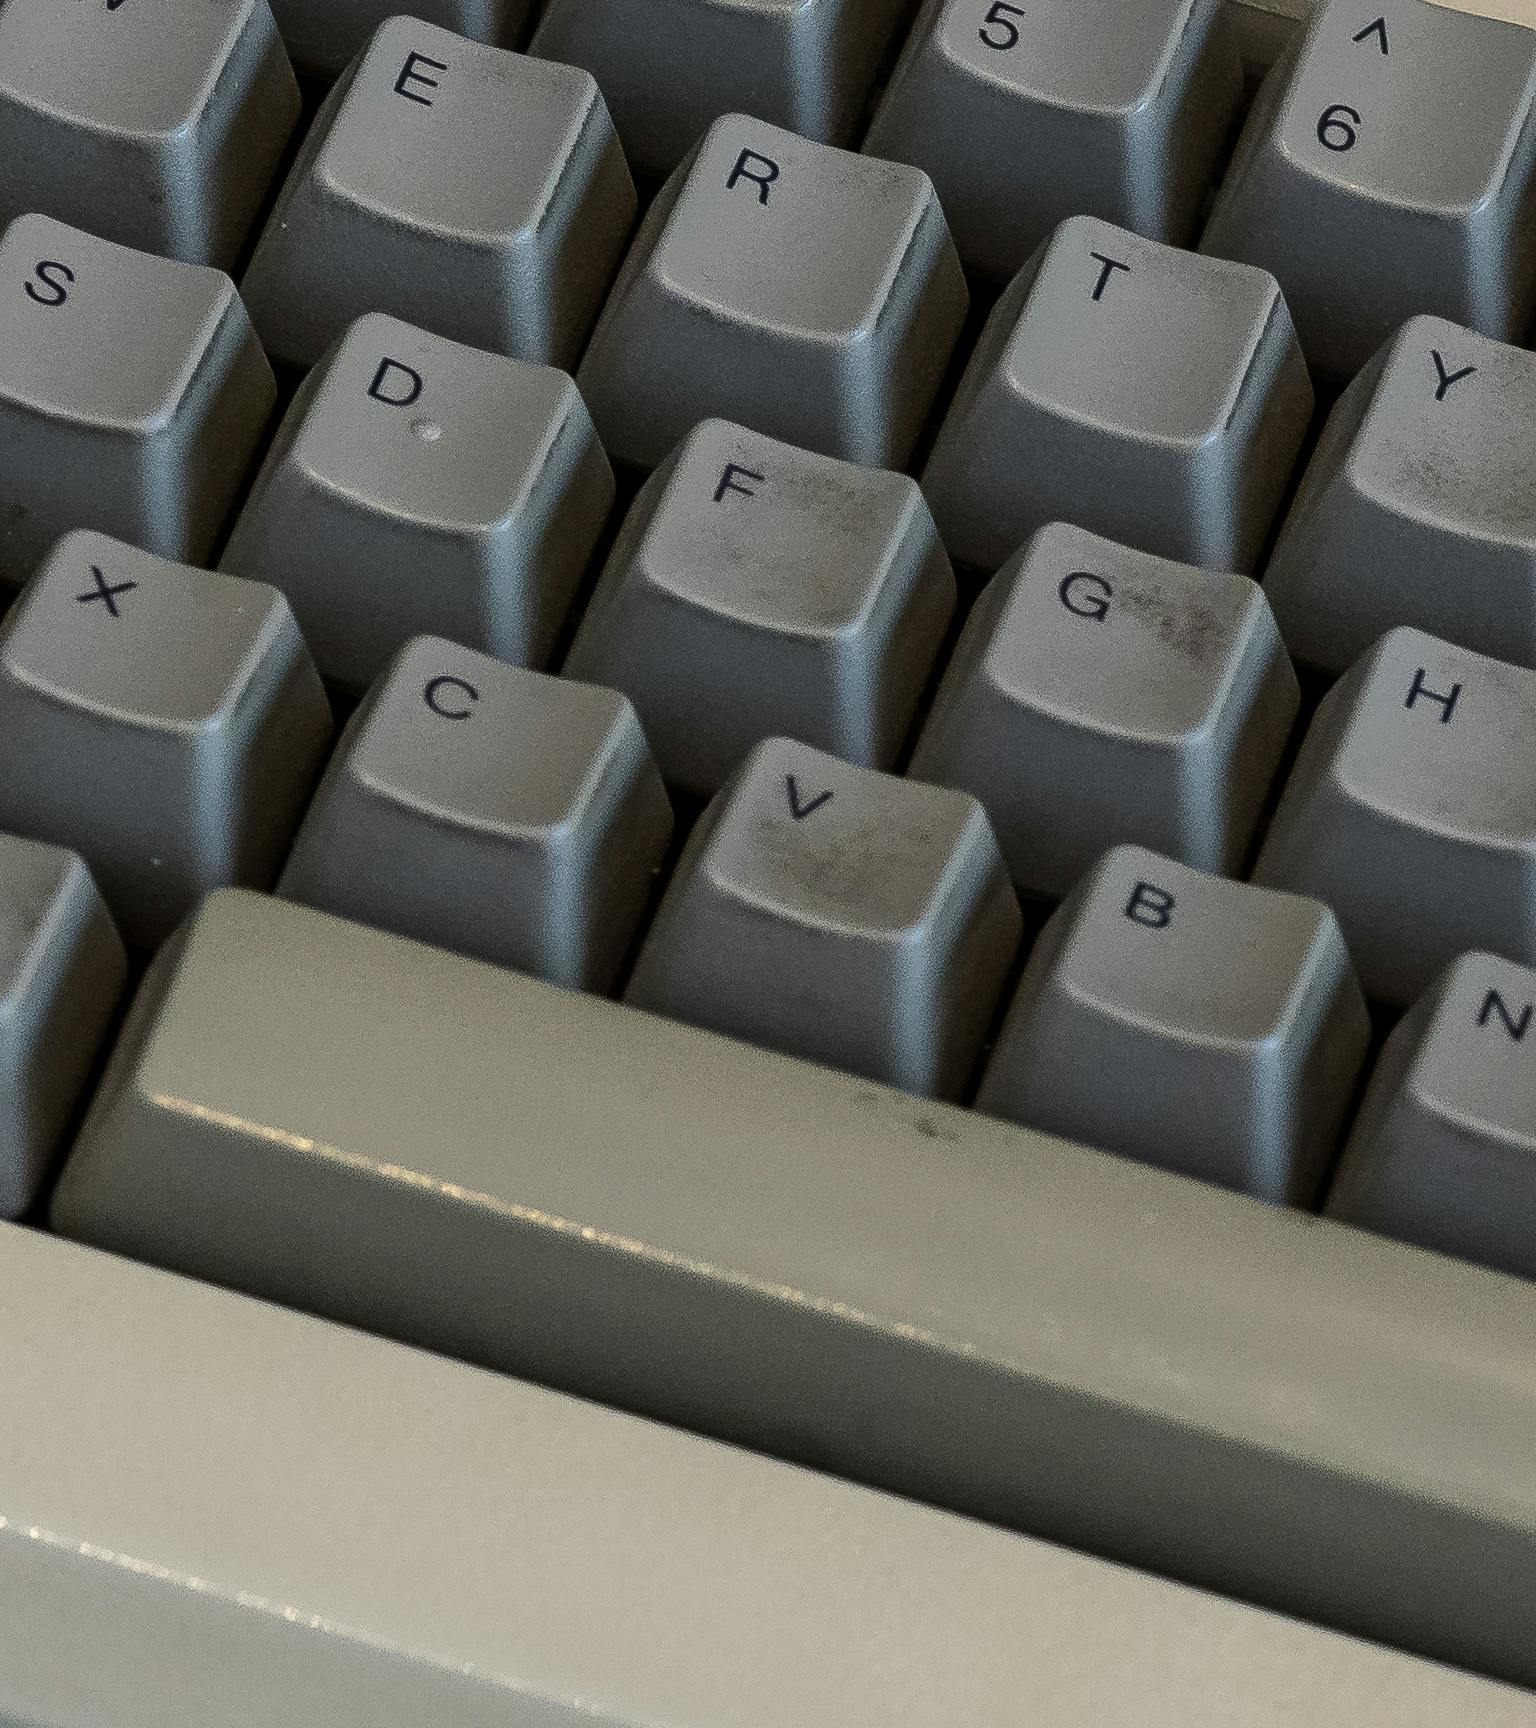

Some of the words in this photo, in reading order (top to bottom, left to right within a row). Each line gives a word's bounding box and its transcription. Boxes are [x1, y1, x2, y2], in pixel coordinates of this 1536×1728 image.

[977, 0, 1026, 52] 5
[392, 50, 449, 107] E
[1315, 103, 1362, 154] 6
[725, 147, 781, 206] R
[23, 259, 76, 308] S
[1090, 251, 1131, 303] T
[366, 356, 425, 408] D
[1430, 349, 1477, 402] Y
[712, 462, 766, 504] F
[76, 565, 138, 619] X
[1057, 570, 1115, 624] G
[422, 674, 481, 722] C
[1403, 667, 1463, 725] H
[784, 773, 835, 822] V
[1123, 880, 1177, 931] B
[1476, 988, 1535, 1043] N
